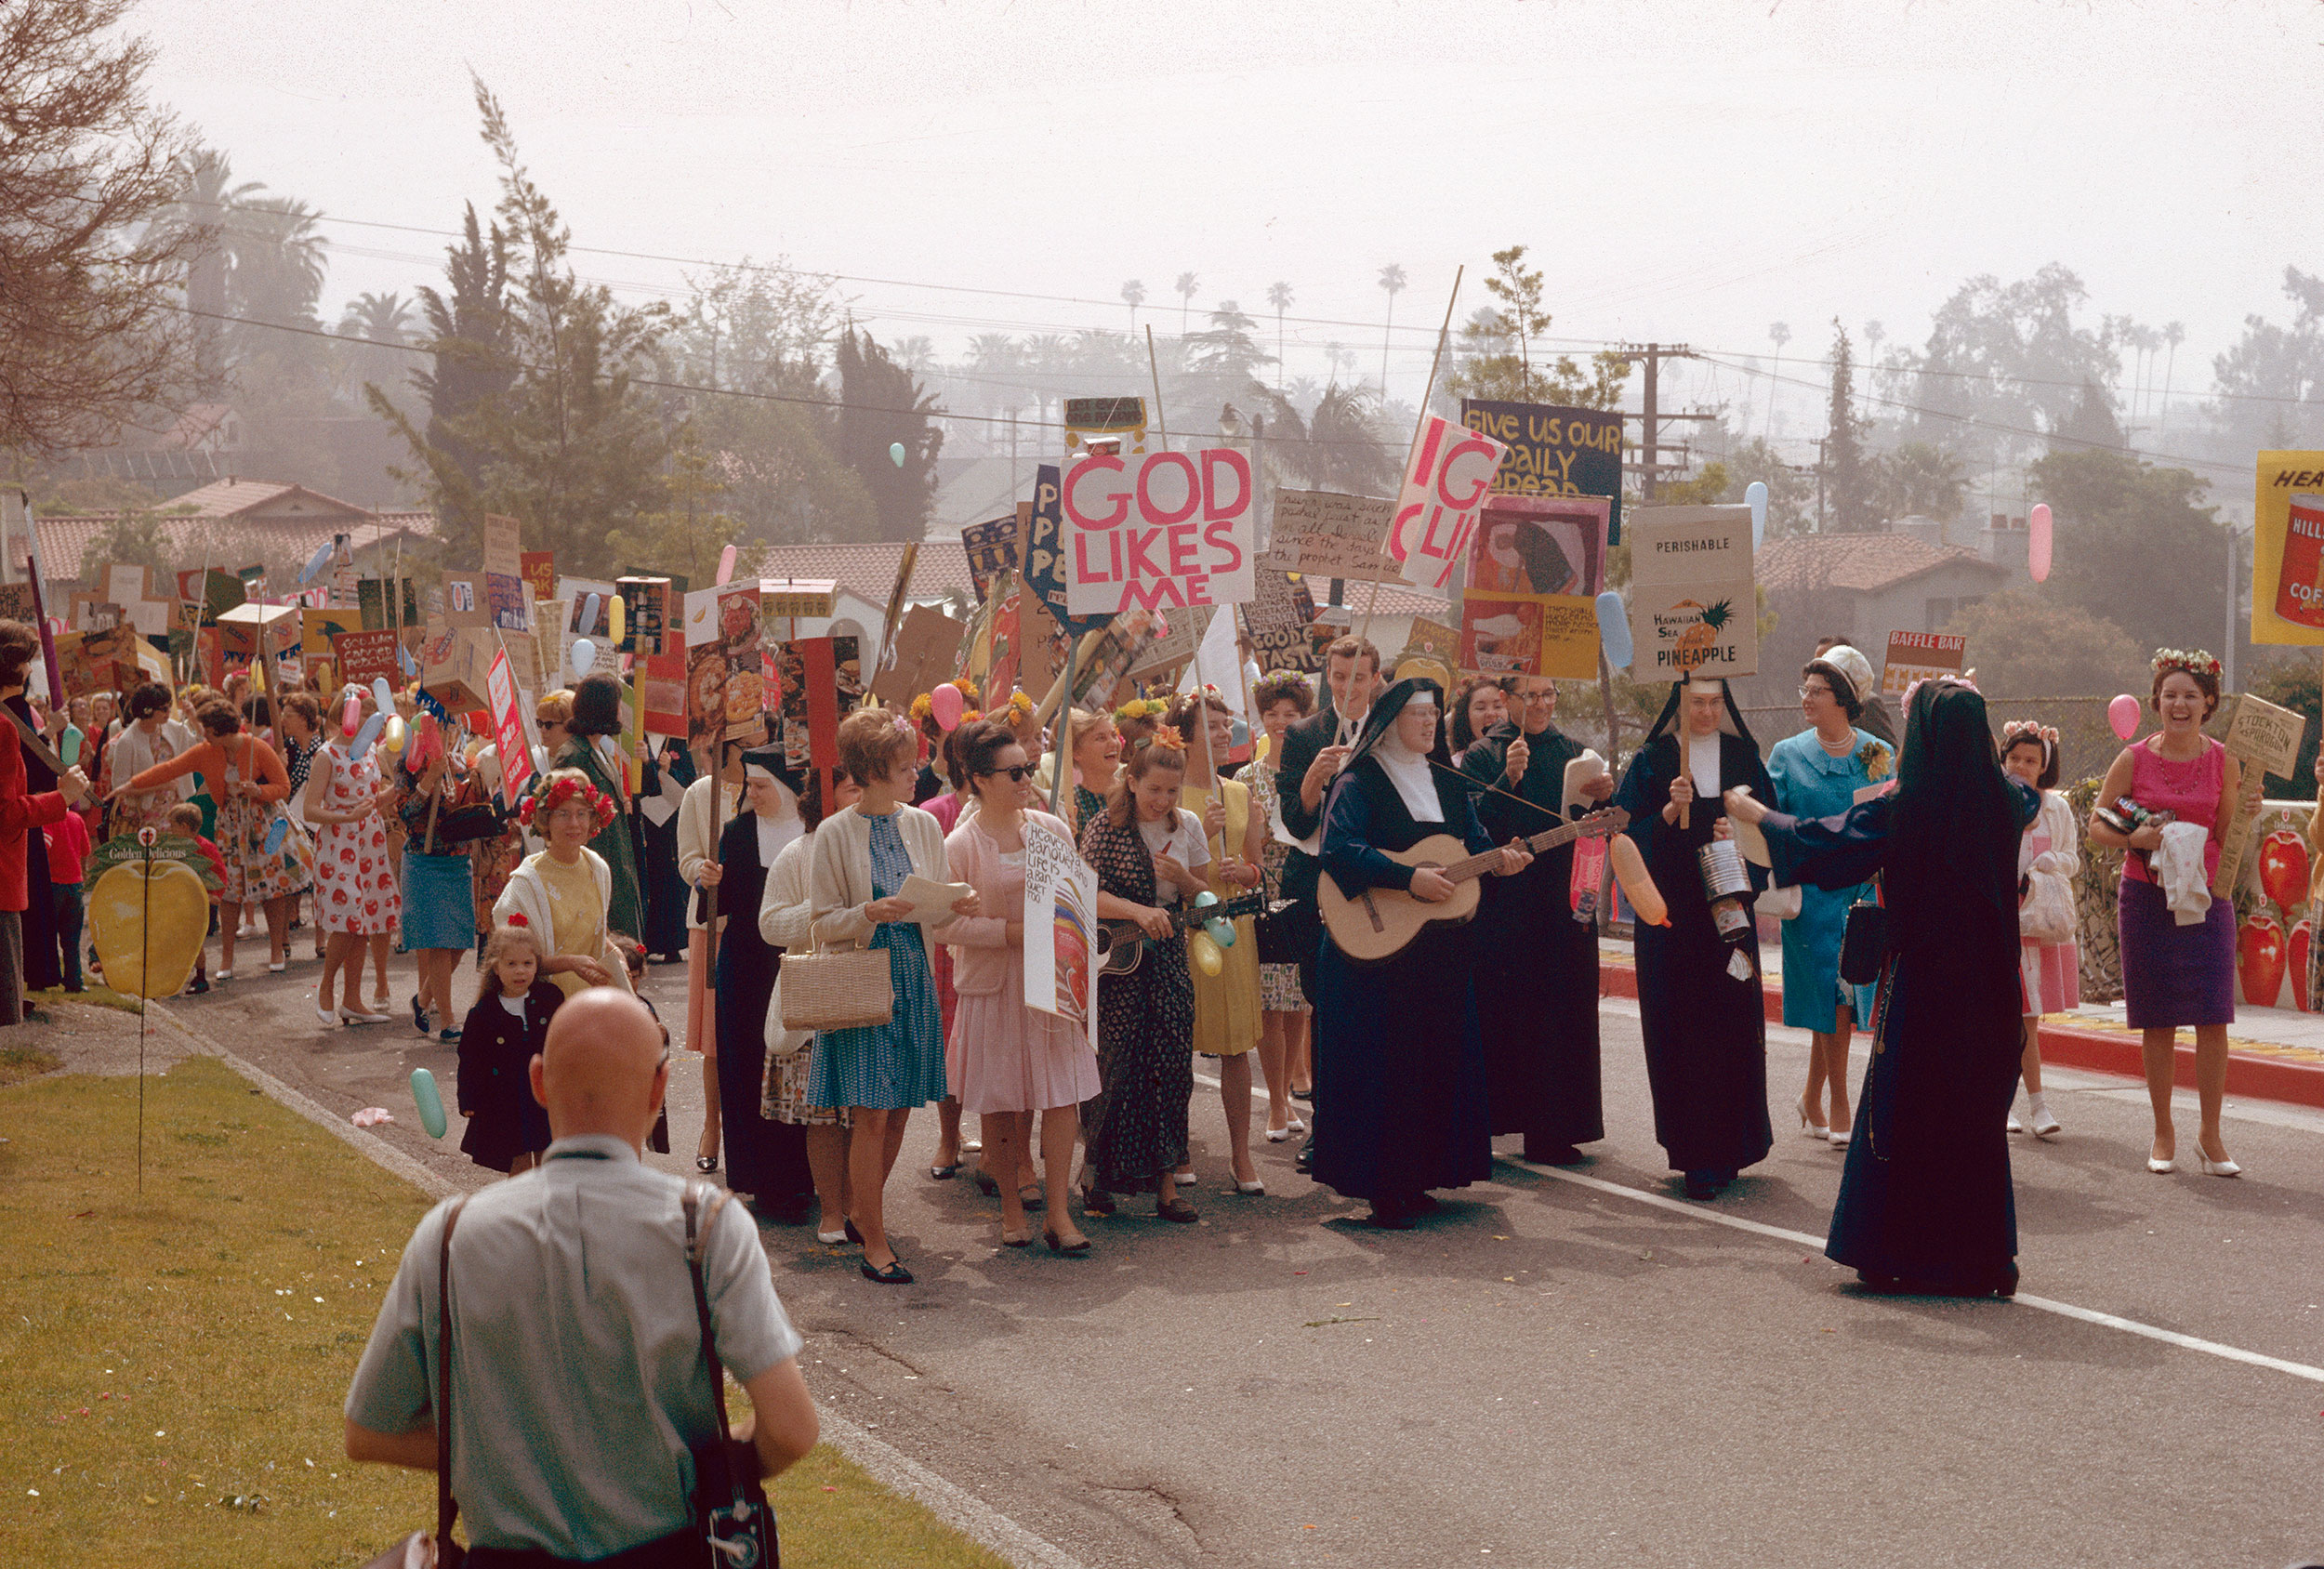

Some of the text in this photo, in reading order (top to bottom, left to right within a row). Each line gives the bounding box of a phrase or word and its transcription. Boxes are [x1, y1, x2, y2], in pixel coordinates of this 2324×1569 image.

[1463, 410, 1621, 455] GIVe US OUR
[1499, 443, 1577, 480] DaILY
[2274, 470, 2324, 487] HEA
[1063, 448, 1252, 531] GOD
[2292, 517, 2324, 540] HILL
[1074, 521, 1242, 584] LIKES
[1657, 537, 1730, 553] PERISHABLE
[1274, 548, 1292, 562] the
[1298, 552, 1341, 566] prophet
[1116, 574, 1212, 613] ME
[2290, 583, 2324, 603] COF
[1654, 614, 1701, 626] HAWAIIAN
[1253, 628, 1301, 650] GOOD
[1658, 627, 1679, 639] SEA
[1890, 631, 1962, 651] BAFFLE BAR
[1657, 646, 1736, 666] PINEAPPLE
[2238, 715, 2291, 752] STOCKTON
[109, 847, 141, 860] Golden
[1050, 862, 1060, 876] IS
